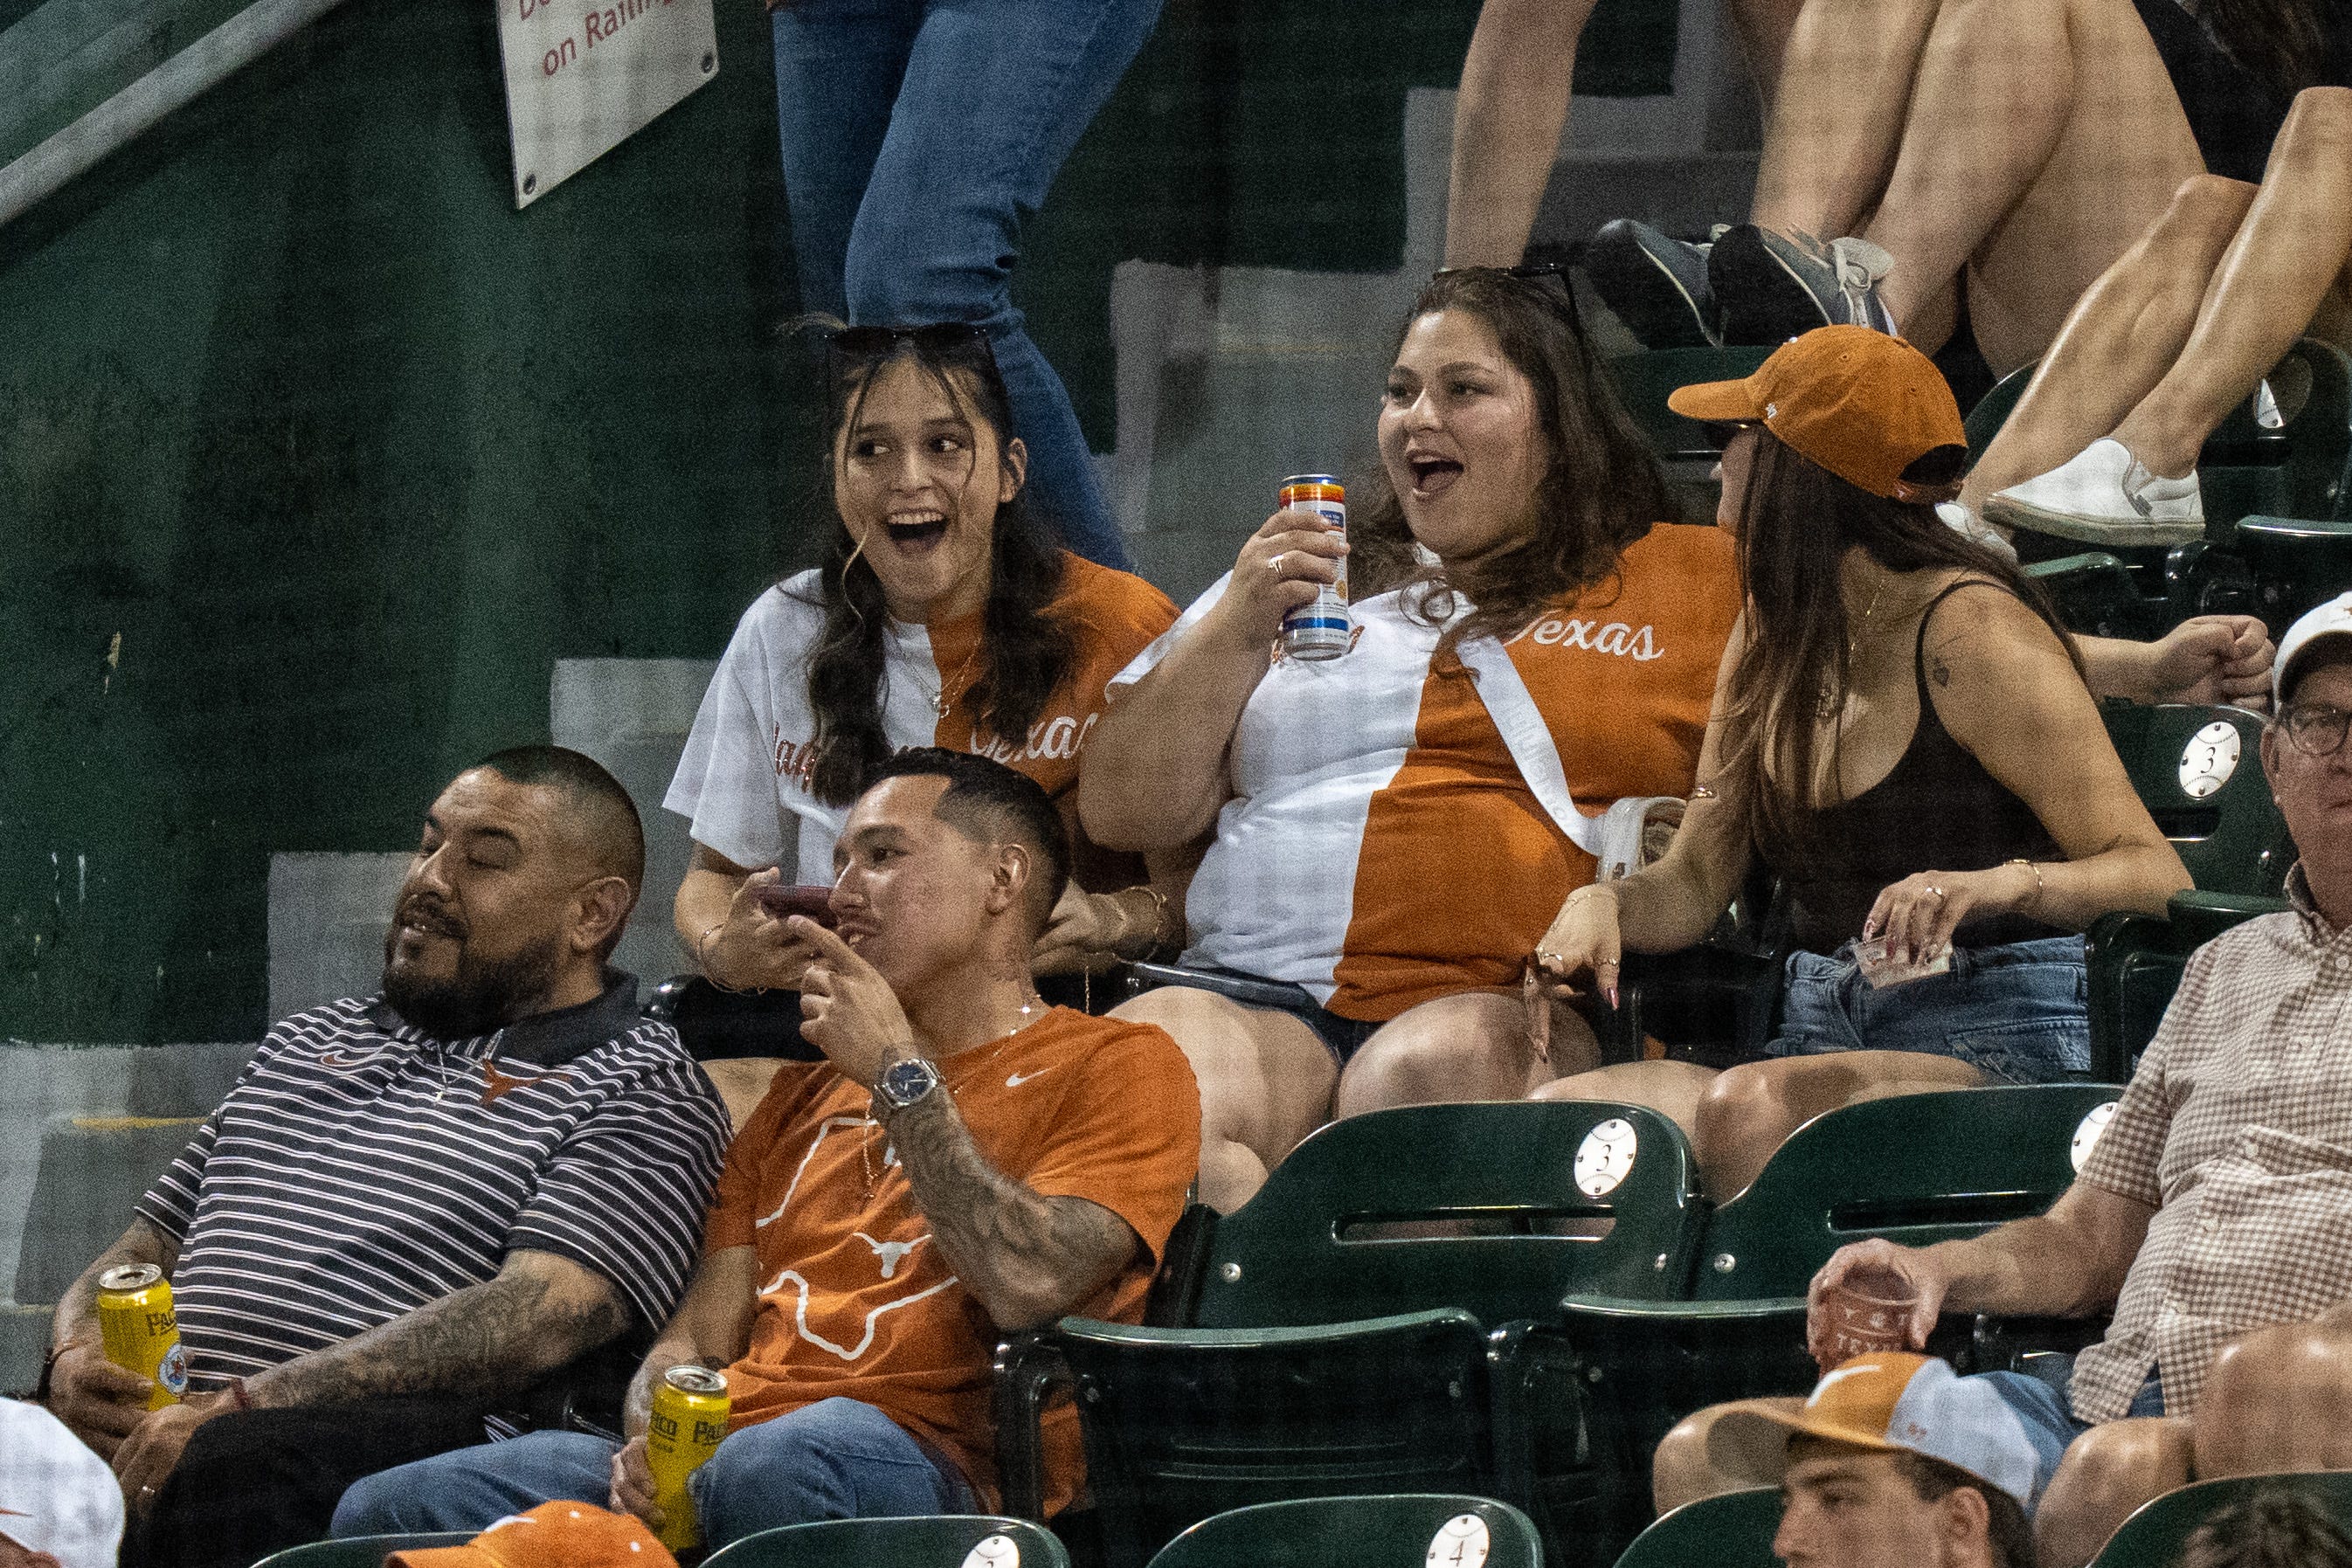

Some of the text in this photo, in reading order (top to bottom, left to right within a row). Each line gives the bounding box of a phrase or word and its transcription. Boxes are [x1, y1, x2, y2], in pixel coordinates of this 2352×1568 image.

[543, 0, 673, 76] on Raili
[1518, 611, 1665, 661] exas
[2200, 746, 2216, 774] 3
[1595, 1143, 1612, 1172] 3
[1449, 1539, 1463, 1567] 4
